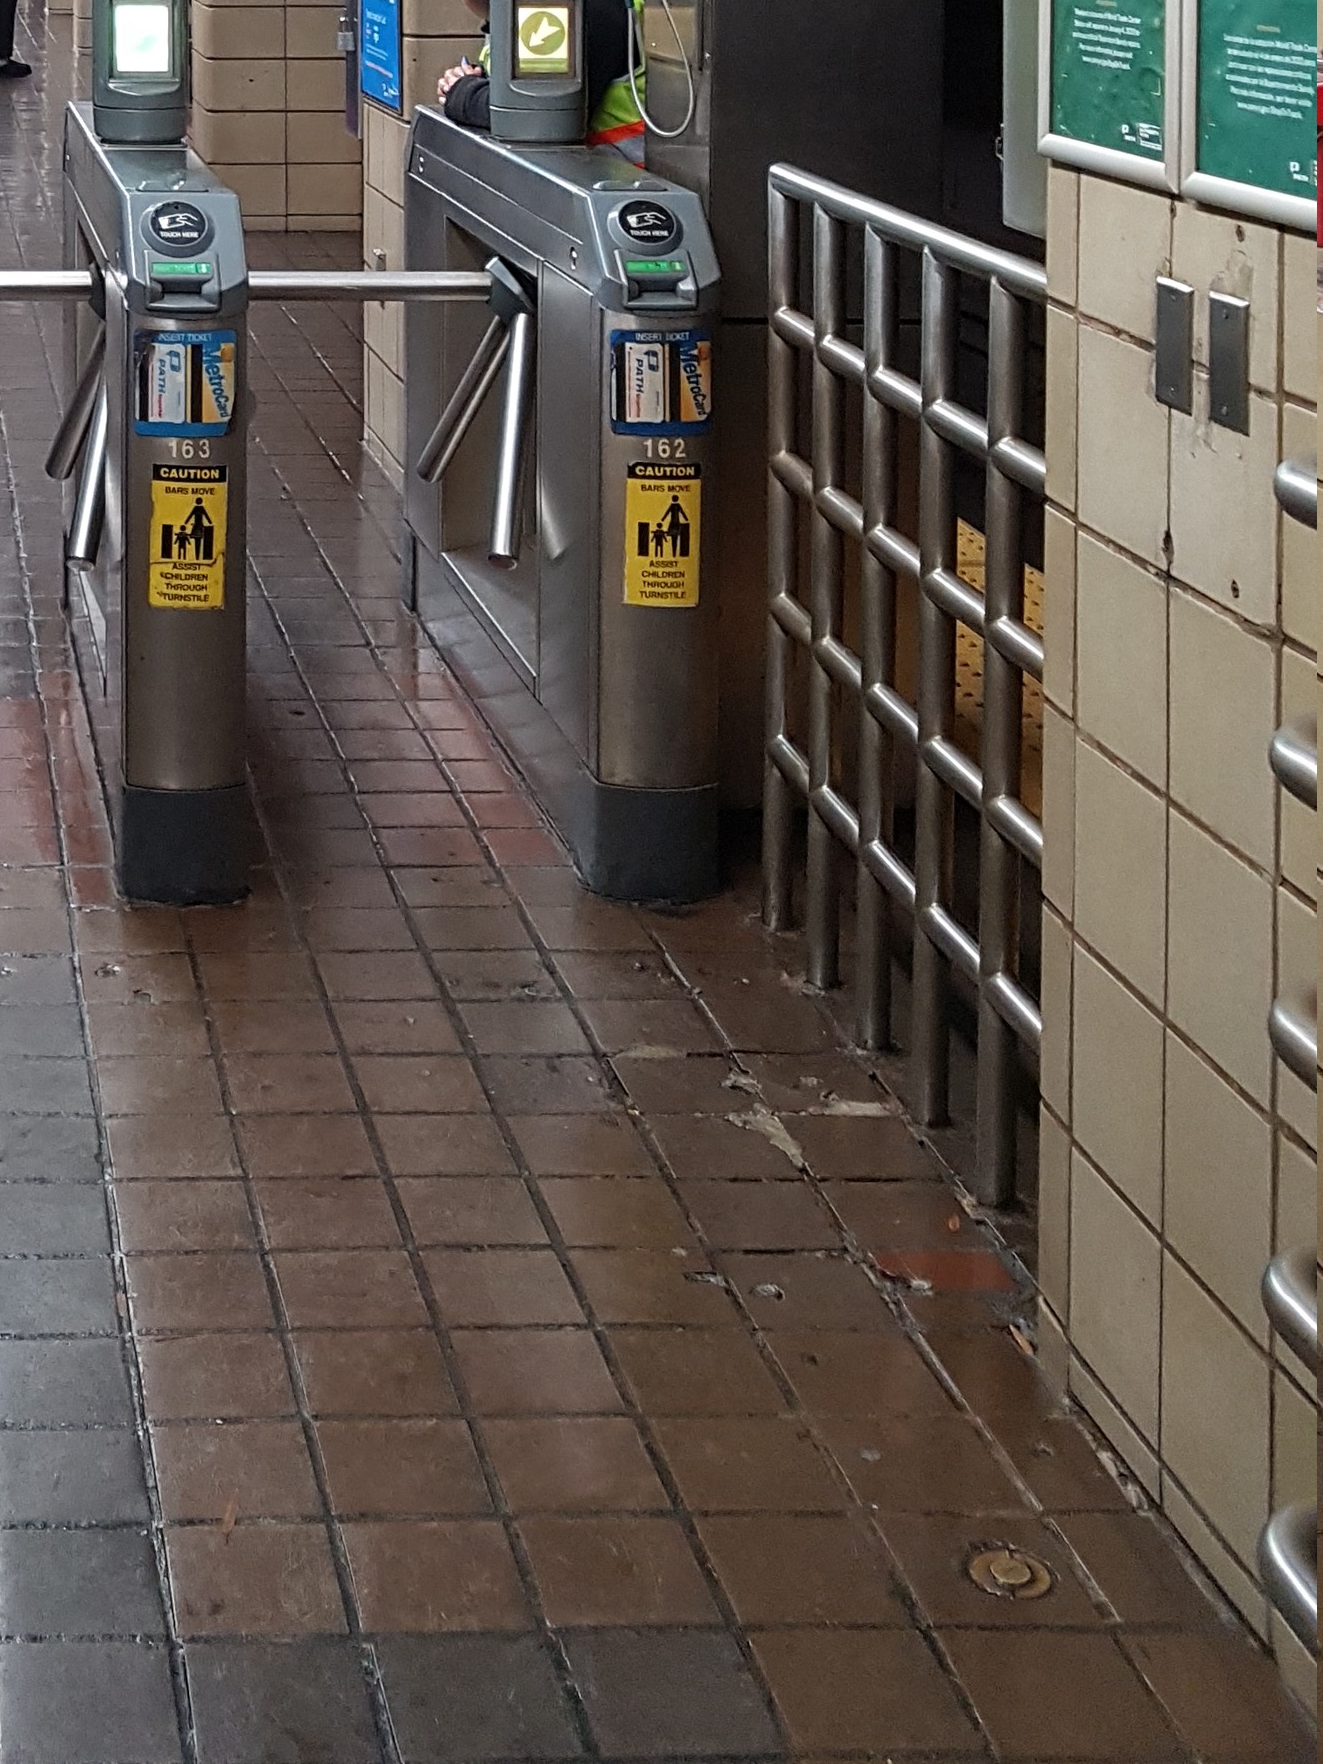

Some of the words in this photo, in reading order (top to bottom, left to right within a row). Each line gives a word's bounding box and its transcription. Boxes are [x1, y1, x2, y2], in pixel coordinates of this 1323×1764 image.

[630, 229, 651, 237] TOUCH
[652, 229, 669, 237] HERE
[635, 332, 662, 341] INSERT
[157, 358, 166, 394] PATH
[635, 357, 644, 394] PATH
[679, 345, 709, 416] MetroCard
[202, 347, 230, 418] MetroCard
[168, 439, 211, 459] 163
[643, 438, 687, 458] 162
[160, 467, 220, 480] CAUTION
[635, 465, 696, 477] CAUTION
[165, 486, 189, 495] BARS
[191, 487, 216, 496] MOVE
[641, 484, 665, 492] BARS
[667, 484, 691, 493] MOVE
[172, 562, 202, 571] ASSIST
[649, 560, 679, 568] ASSIST
[164, 573, 209, 582] CHILDREN
[641, 570, 685, 579] CHILDREN
[165, 582, 208, 592] THROUGH
[642, 580, 685, 589] THROUGH
[162, 593, 210, 603] TURNSTILE
[639, 591, 686, 600] TURNSTILE
